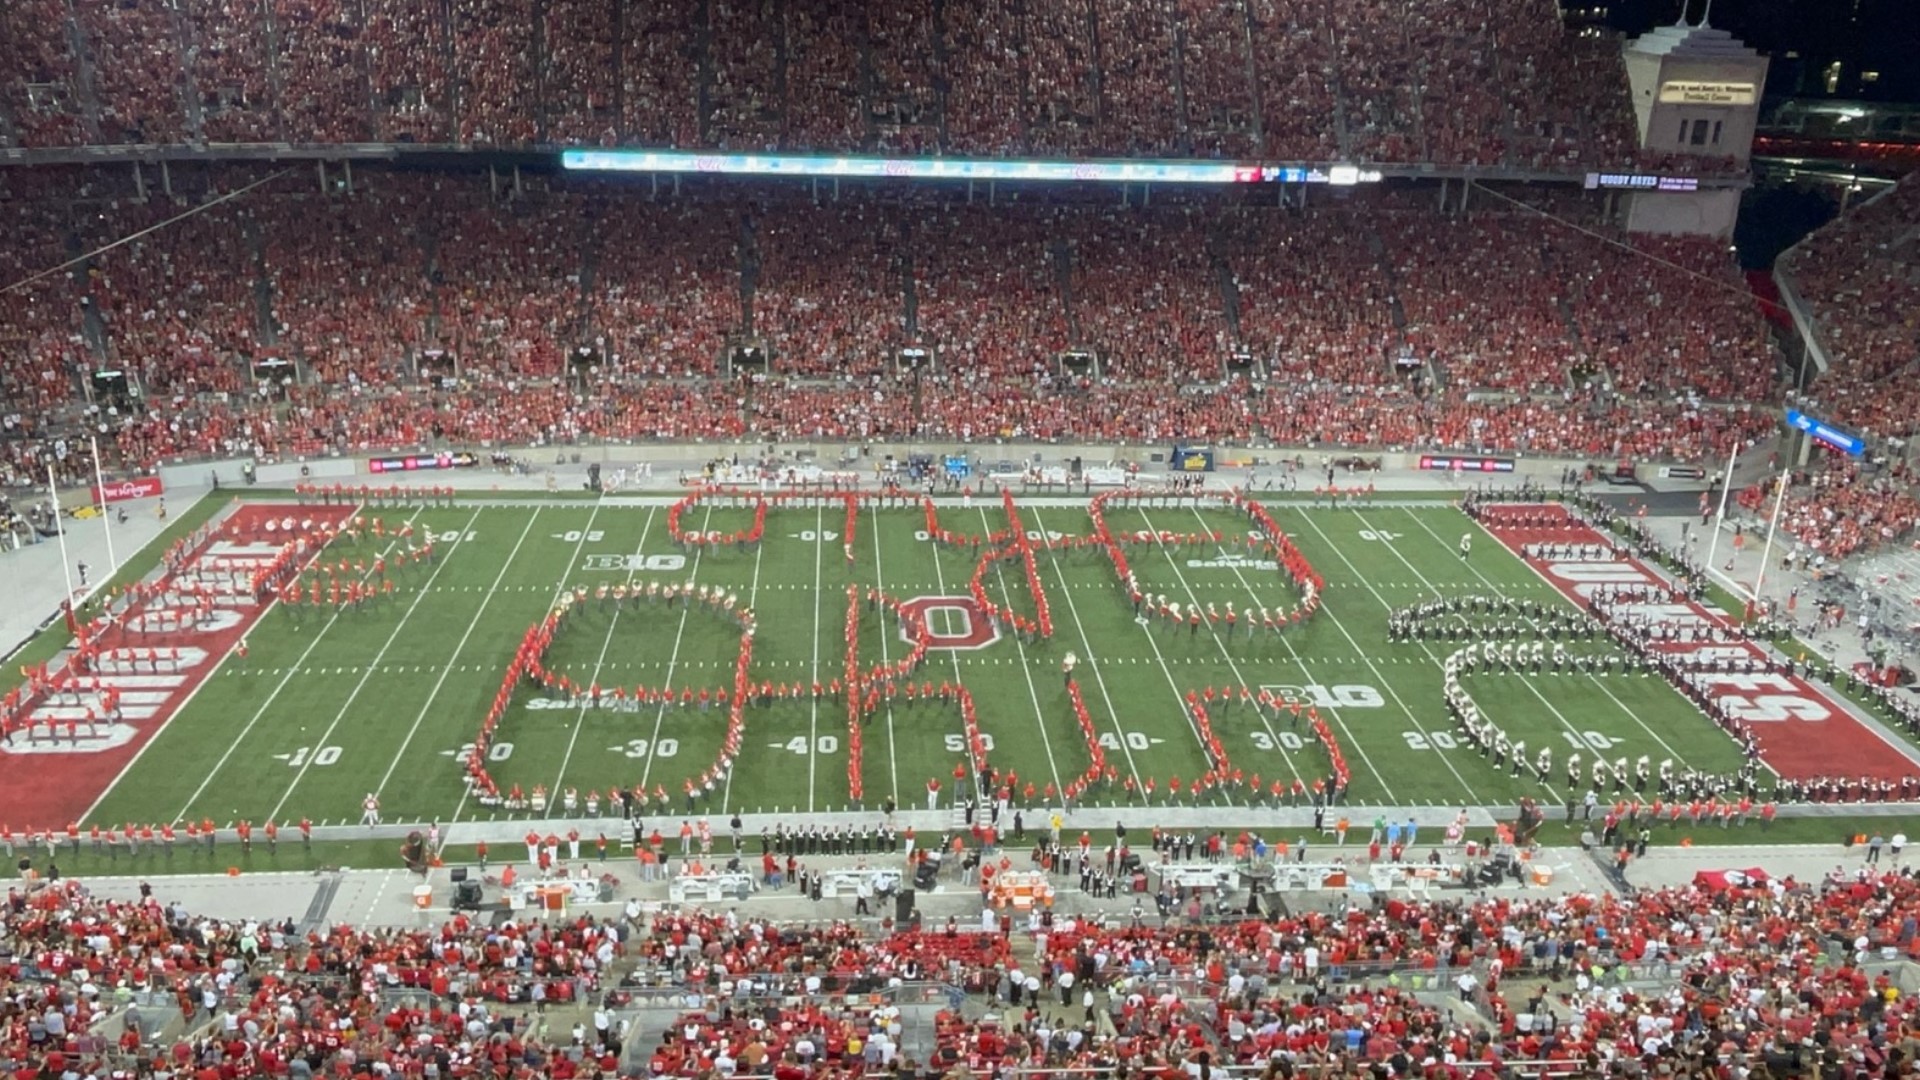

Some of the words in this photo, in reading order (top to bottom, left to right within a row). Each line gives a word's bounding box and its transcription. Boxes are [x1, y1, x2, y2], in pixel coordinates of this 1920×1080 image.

[1600, 174, 1629, 185] WOODY
[1630, 175, 1658, 186] HAYES
[625, 738, 679, 757] 30
[786, 736, 838, 754] 40
[945, 733, 995, 752] 50
[1098, 731, 1149, 750] 40
[1249, 731, 1302, 749] 30
[1402, 731, 1459, 749] 20
[1562, 731, 1613, 749] 10
[288, 746, 343, 766] 10
